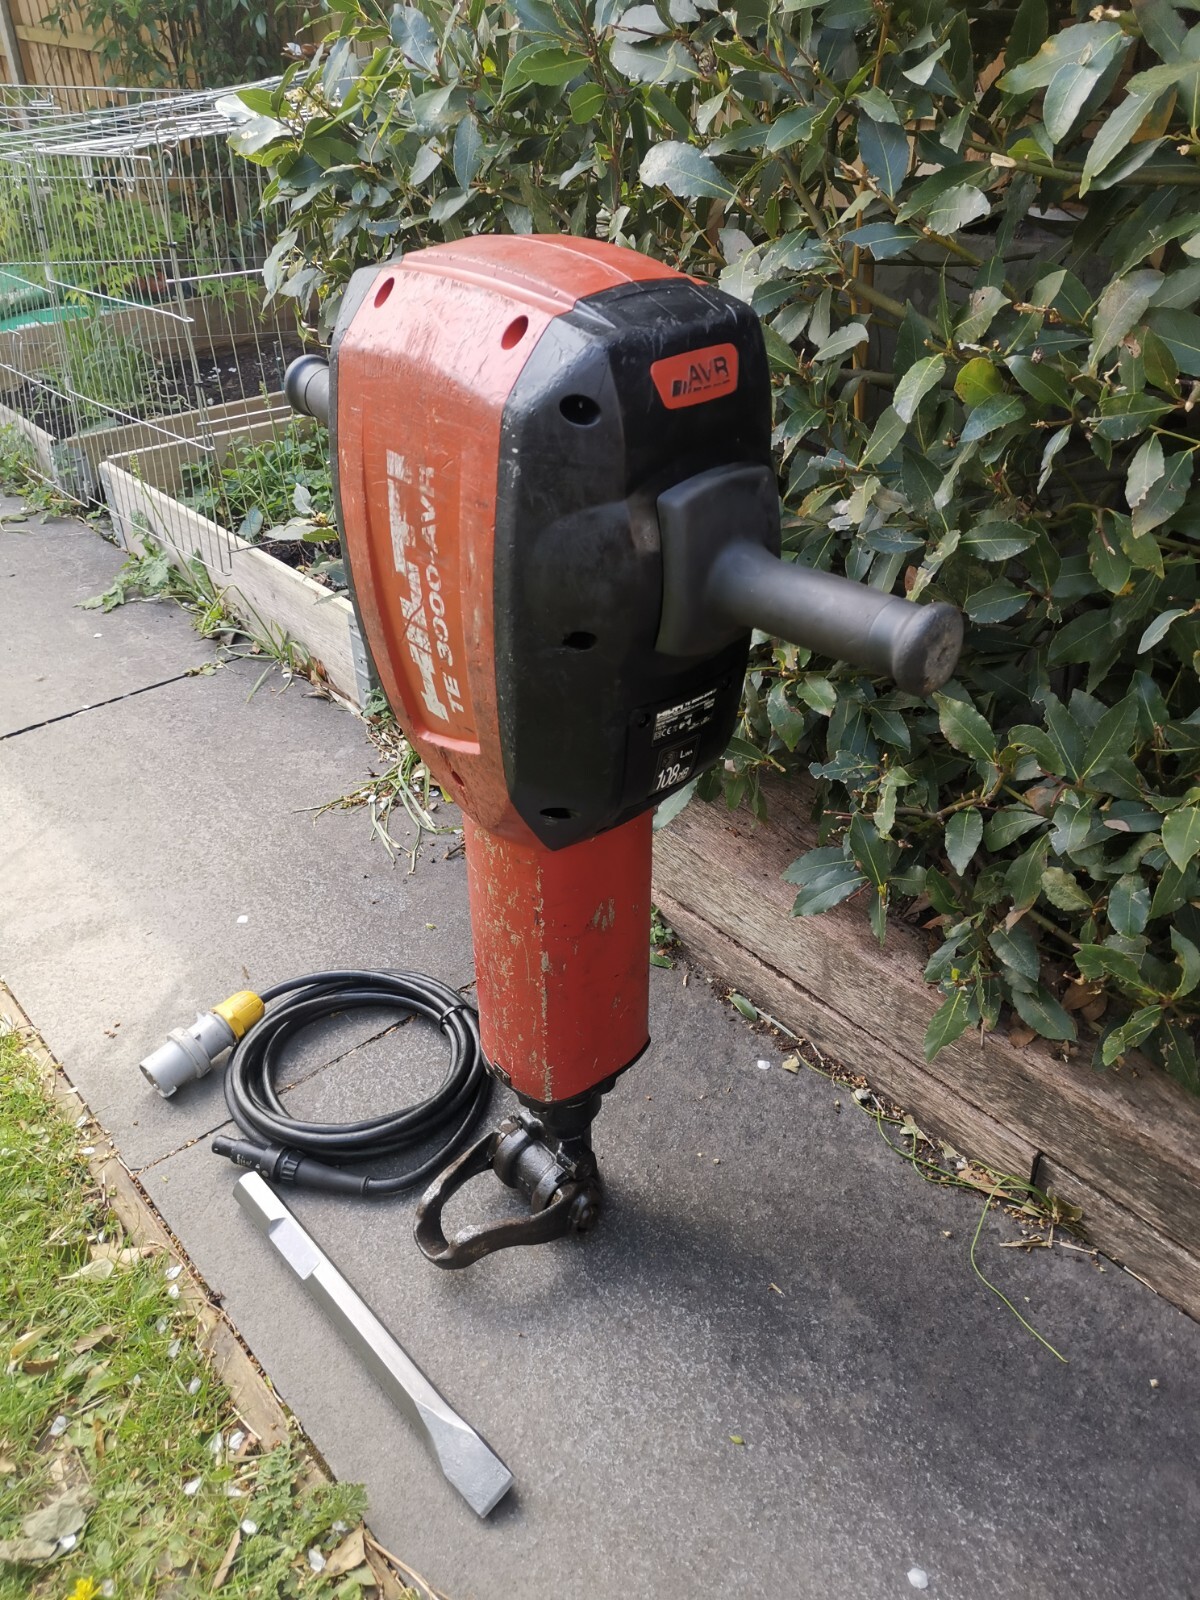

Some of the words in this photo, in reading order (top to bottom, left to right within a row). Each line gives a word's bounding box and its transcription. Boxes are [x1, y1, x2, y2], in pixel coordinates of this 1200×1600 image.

[687, 356, 729, 390] AVR
[386, 448, 450, 723] HILTI
[418, 464, 453, 667] 3000-AVR
[443, 671, 464, 713] TE
